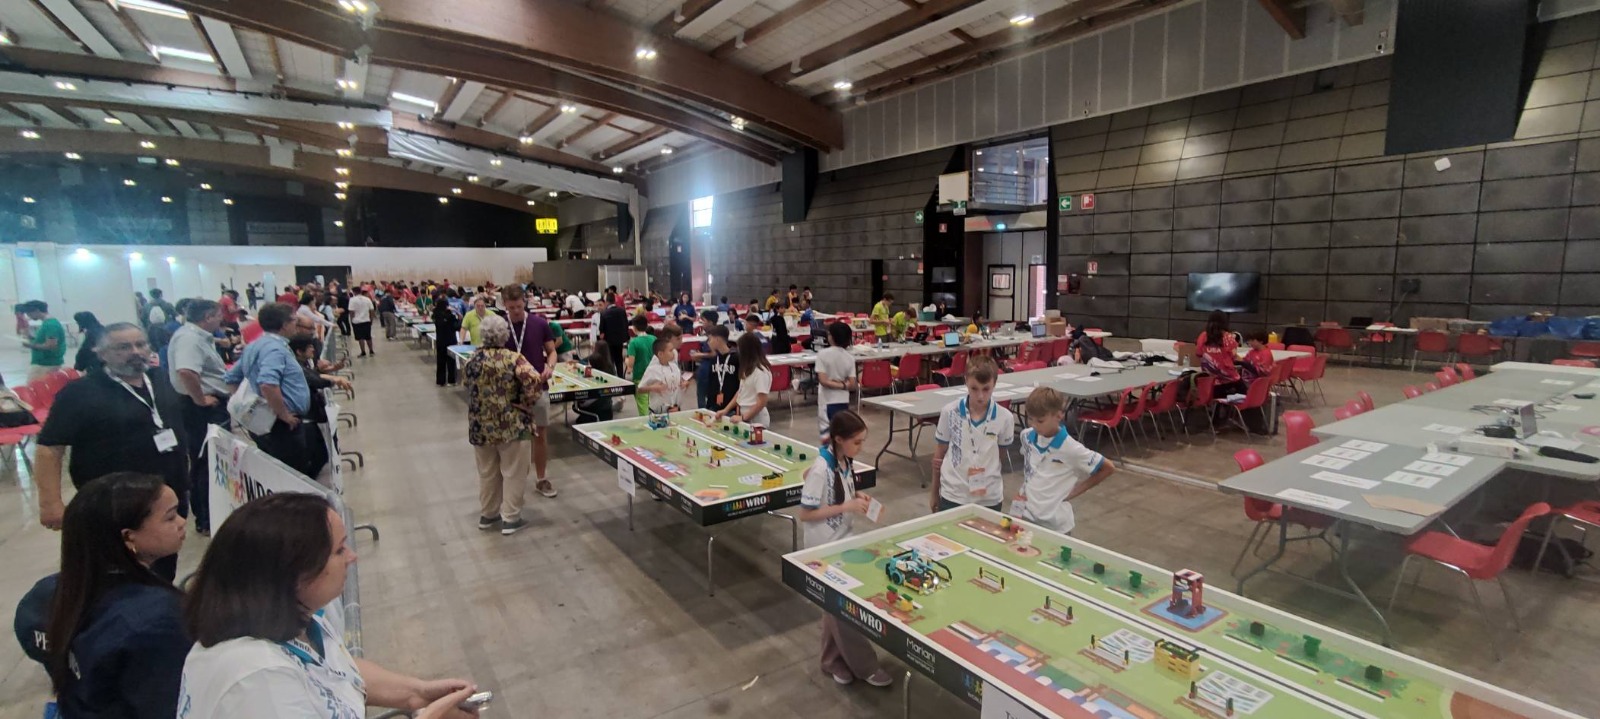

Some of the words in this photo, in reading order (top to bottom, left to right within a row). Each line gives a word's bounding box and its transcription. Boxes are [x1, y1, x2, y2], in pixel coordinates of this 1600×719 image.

[243, 472, 274, 501] WR
[744, 494, 767, 508] WRO
[859, 607, 883, 633] WRO
[906, 637, 936, 663] Mariani
